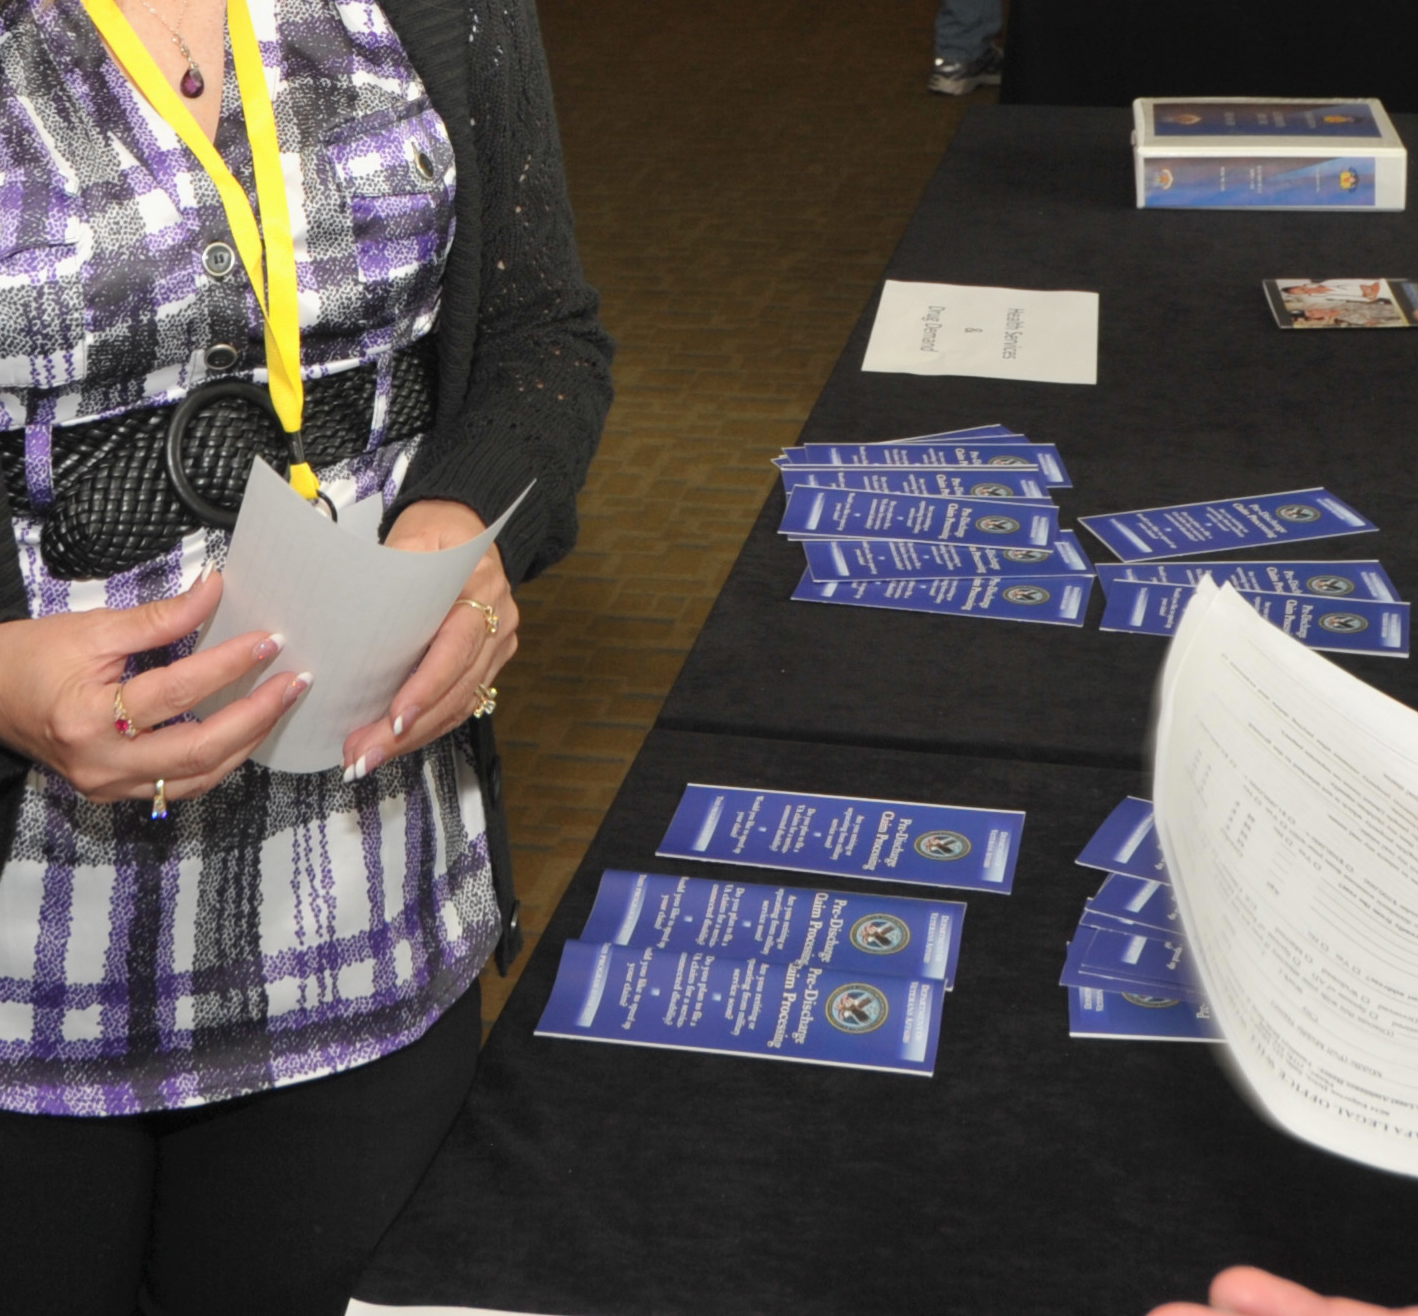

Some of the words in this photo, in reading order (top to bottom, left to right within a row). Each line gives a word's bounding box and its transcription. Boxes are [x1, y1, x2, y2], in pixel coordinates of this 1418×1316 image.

[921, 306, 945, 322] Drug
[1005, 308, 1025, 330] Health
[920, 323, 943, 352] Demand
[1002, 331, 1023, 359] Services
[877, 811, 895, 833] Claim
[862, 834, 889, 870] Processing
[884, 818, 913, 868] Pre-Discharge
[811, 892, 829, 918] Claim
[795, 920, 823, 966] Processing
[819, 899, 847, 962] Pre-Discharge
[687, 961, 699, 984] claim
[701, 966, 710, 982] you
[729, 968, 741, 996] service
[755, 976, 765, 992] you
[739, 992, 751, 1011] from
[747, 993, 762, 1022] retiring
[791, 968, 823, 1044] Pre-Discharge
[767, 992, 797, 1048] Processing
[1333, 1106, 1390, 1132] LEGAL
